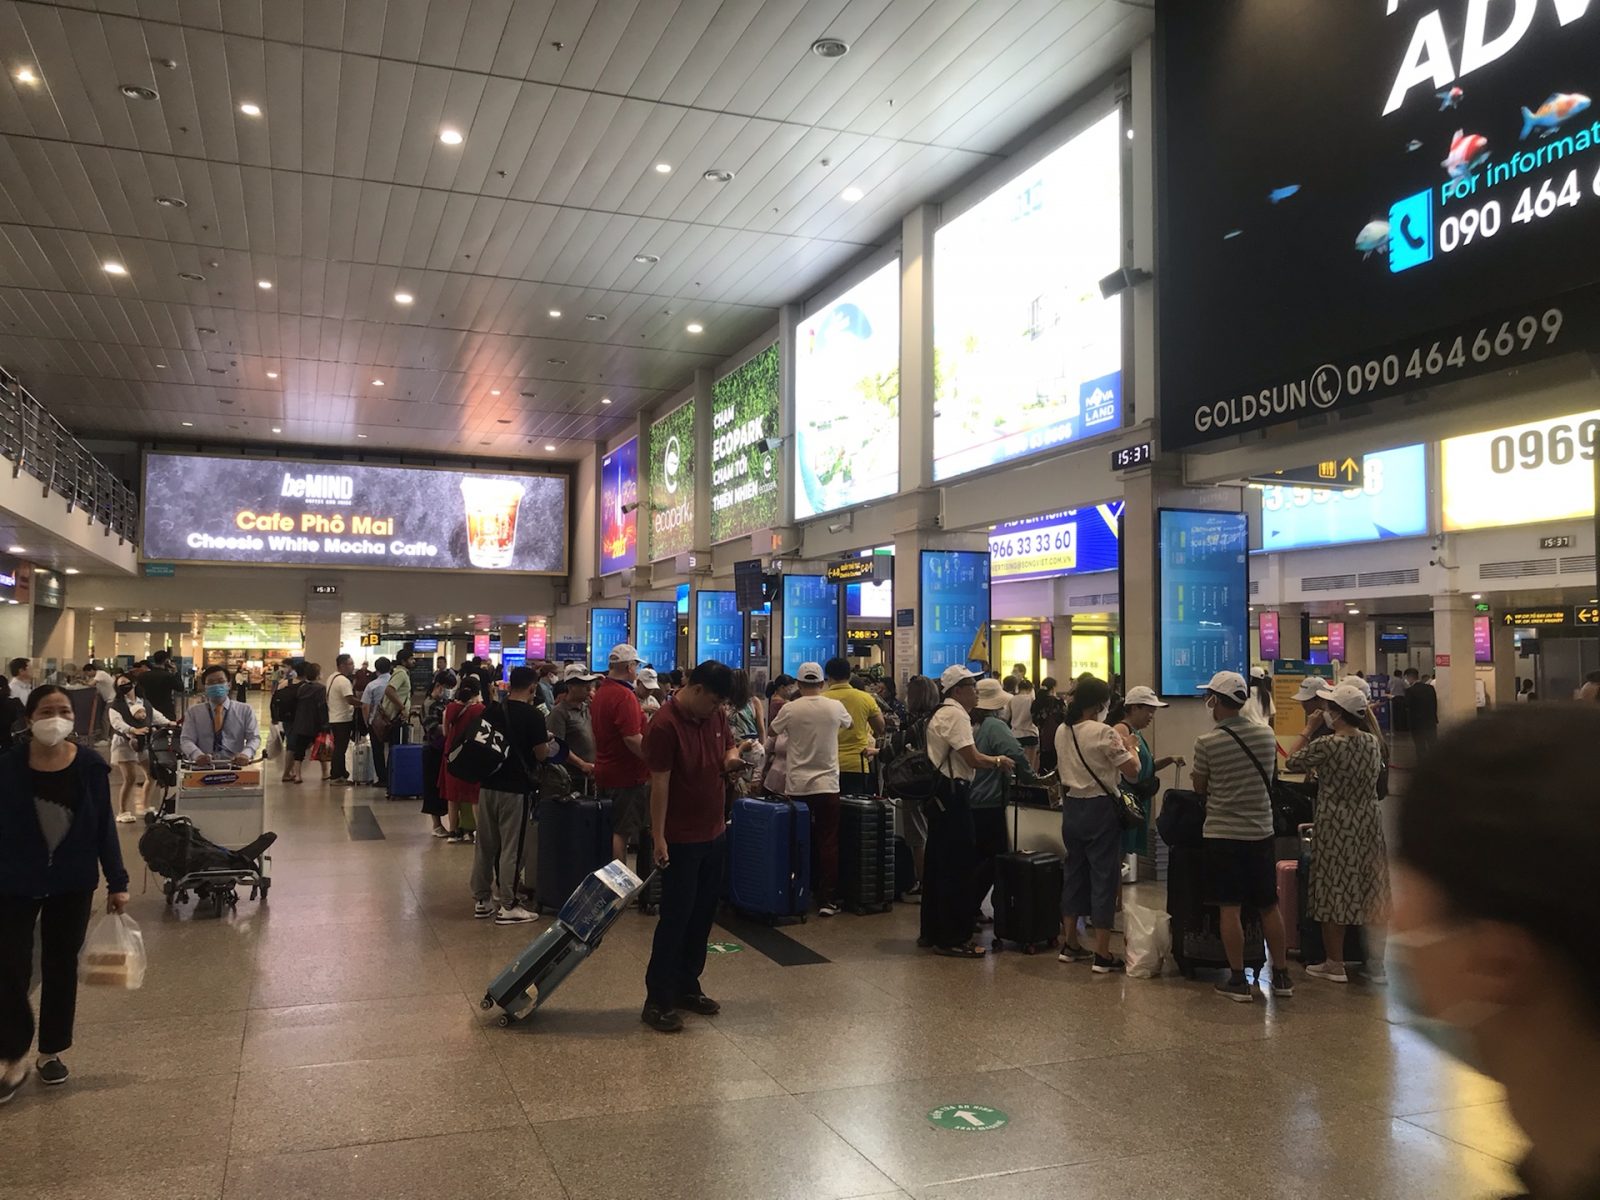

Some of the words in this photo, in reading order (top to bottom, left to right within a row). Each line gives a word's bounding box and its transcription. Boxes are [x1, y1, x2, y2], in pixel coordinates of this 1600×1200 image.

[1441, 173, 1480, 206] For
[1440, 200, 1501, 253] 090
[1511, 169, 1581, 224] 464
[1085, 404, 1115, 422] LAND
[1194, 380, 1306, 432] GOLDSUN
[713, 414, 765, 462] ECOPARK
[1118, 444, 1149, 465] 15:37
[281, 472, 354, 500] beMIND
[236, 511, 295, 532] Cafe
[301, 514, 345, 534] Phô
[351, 516, 394, 536] Mai
[268, 536, 320, 553] White
[324, 538, 386, 555] Mocha
[1017, 536, 1031, 555] 33
[1036, 533, 1051, 552] 33
[1055, 530, 1071, 549] 60
[1544, 537, 1568, 547] 15:37
